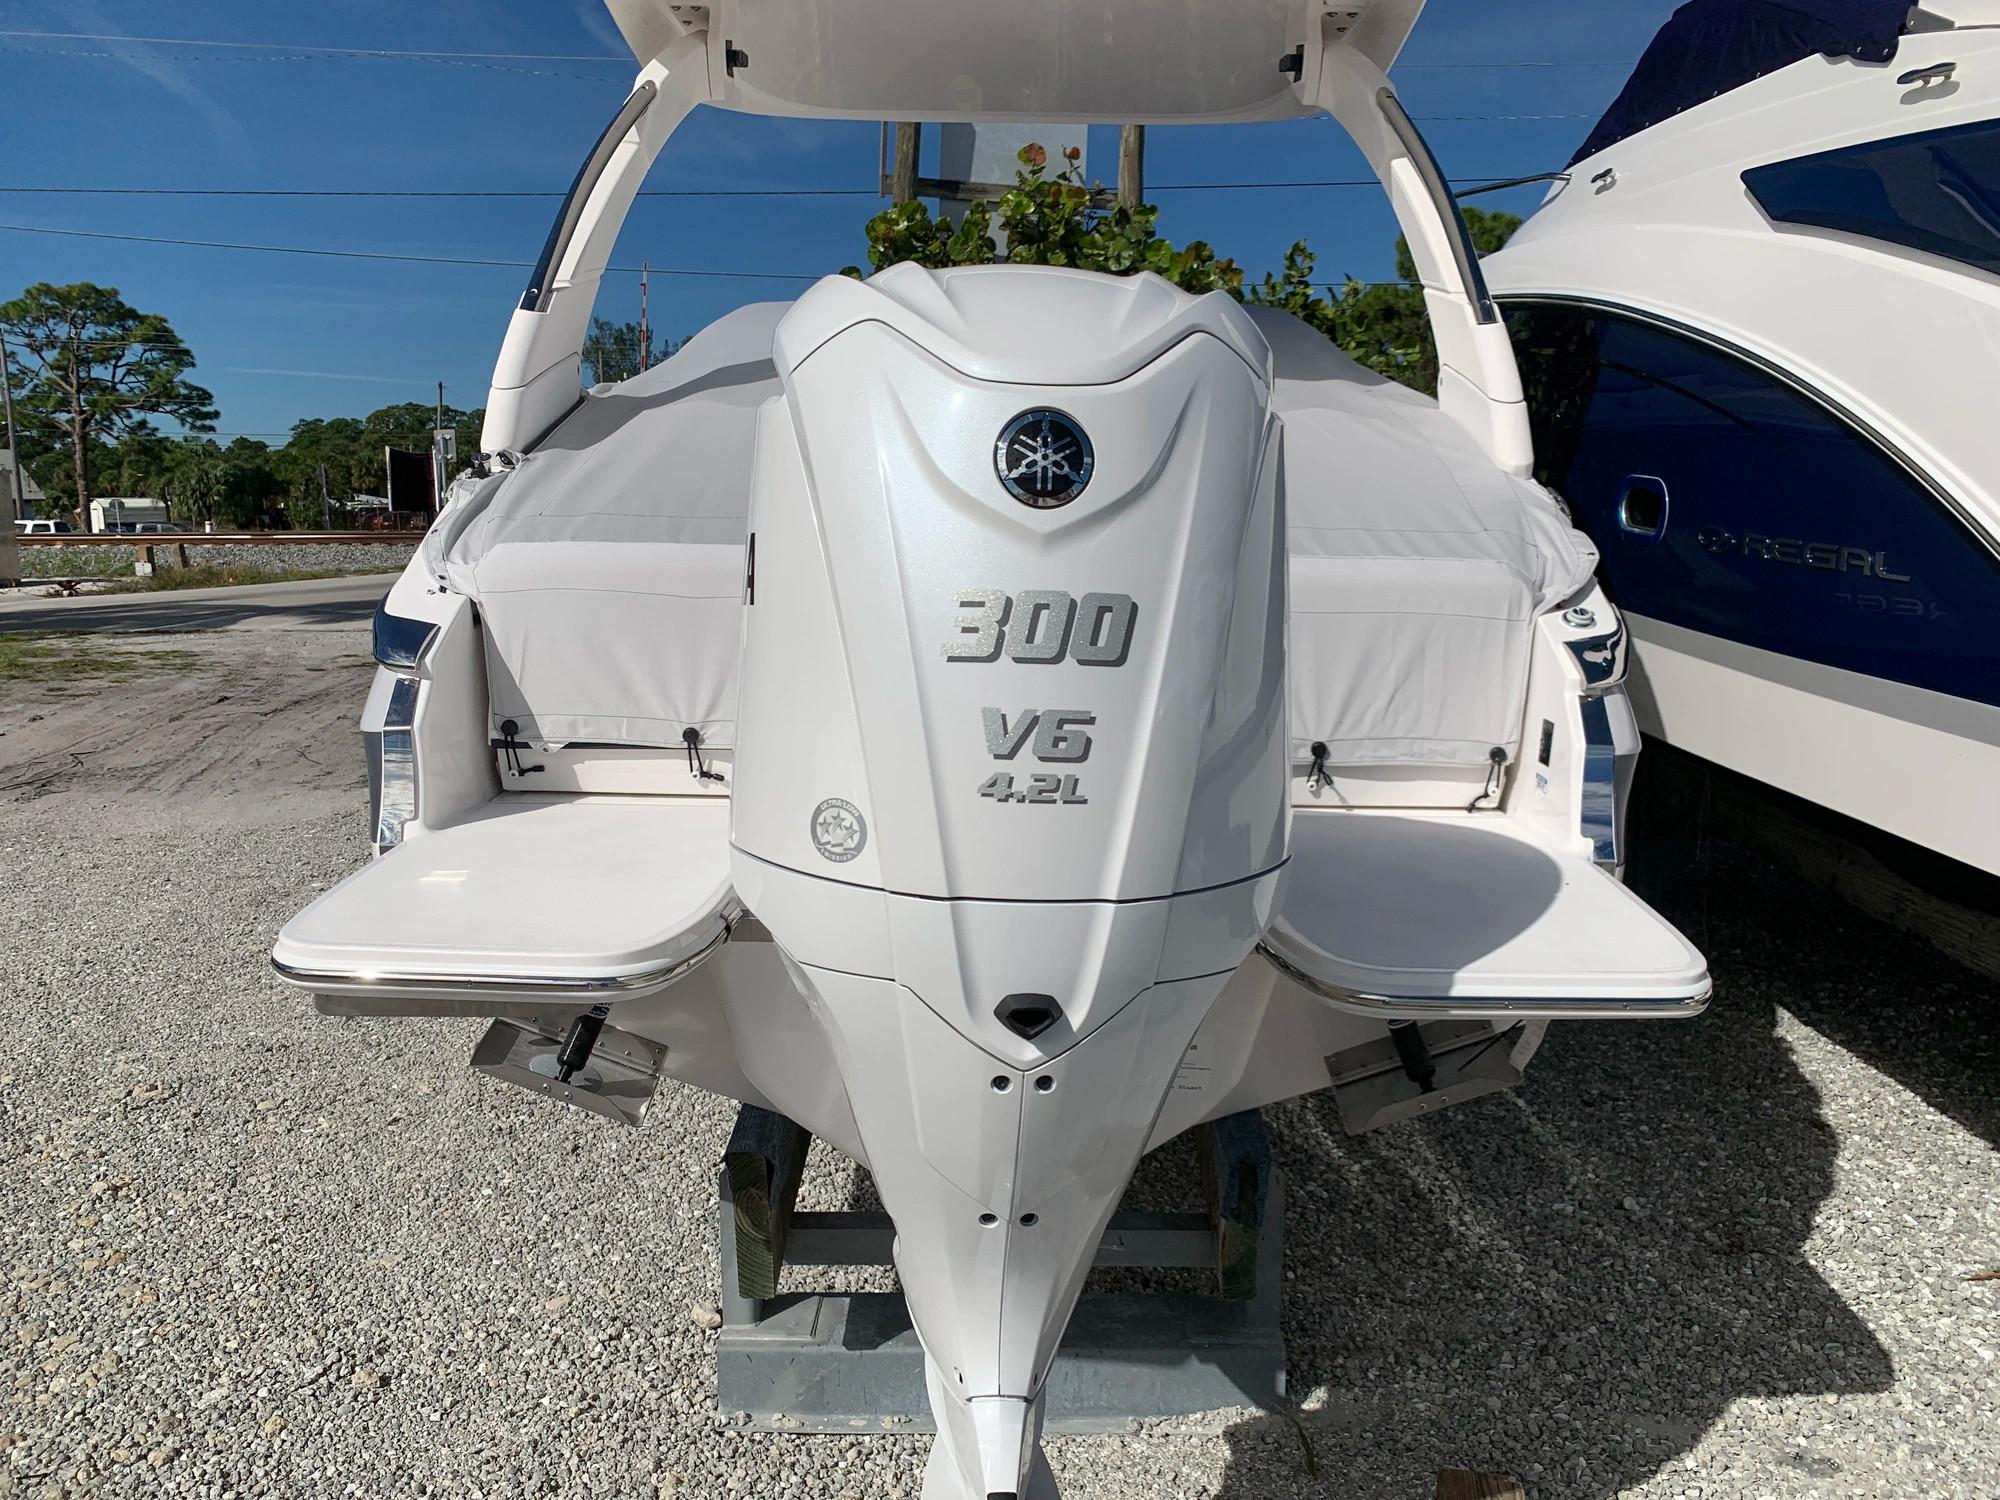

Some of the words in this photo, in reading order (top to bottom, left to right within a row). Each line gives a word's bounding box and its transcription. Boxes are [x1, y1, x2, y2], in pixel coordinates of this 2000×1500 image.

[1743, 532, 1912, 582] REGAL
[941, 588, 1139, 667] 300
[981, 706, 1097, 763] V6
[977, 772, 1088, 804] 4.2L
